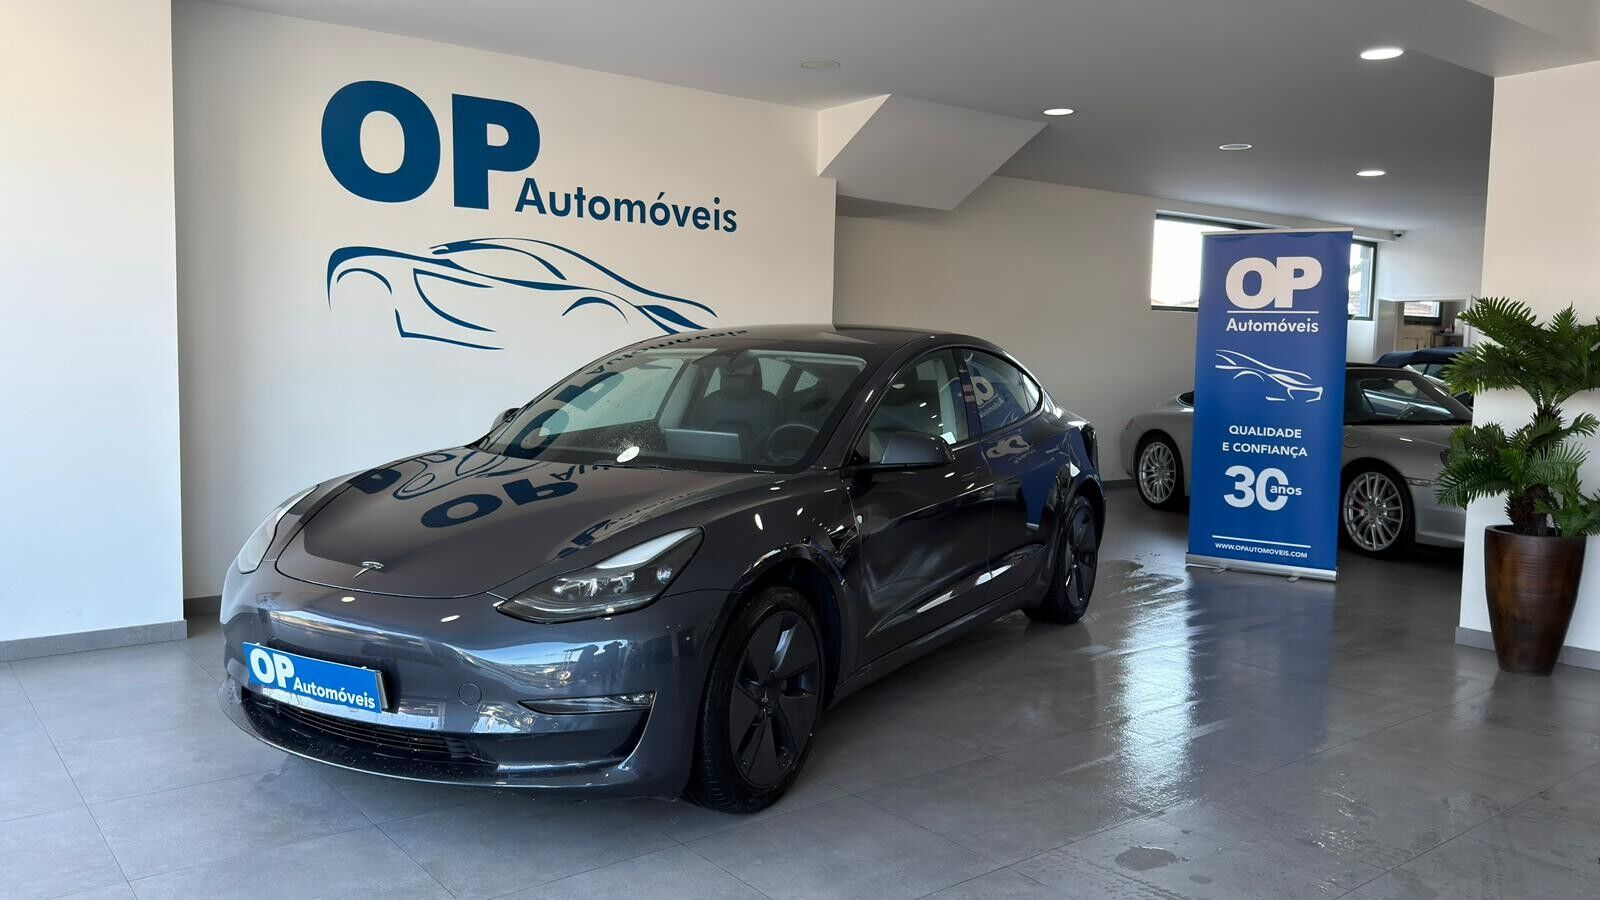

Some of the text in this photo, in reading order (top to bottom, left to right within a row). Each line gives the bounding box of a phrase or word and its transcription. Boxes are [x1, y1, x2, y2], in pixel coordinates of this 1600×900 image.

[321, 80, 738, 233] OP Automóveis
[1225, 256, 1323, 310] OP
[1226, 318, 1319, 333] Automóveis
[1229, 425, 1302, 439] QUALIDADE
[1222, 442, 1308, 459] E CONFIANÇA
[1224, 465, 1302, 511] 30 anos
[1215, 542, 1308, 558] WWW.OPAUTOMOVEIS.COM
[250, 648, 376, 709] OP Automóveis
